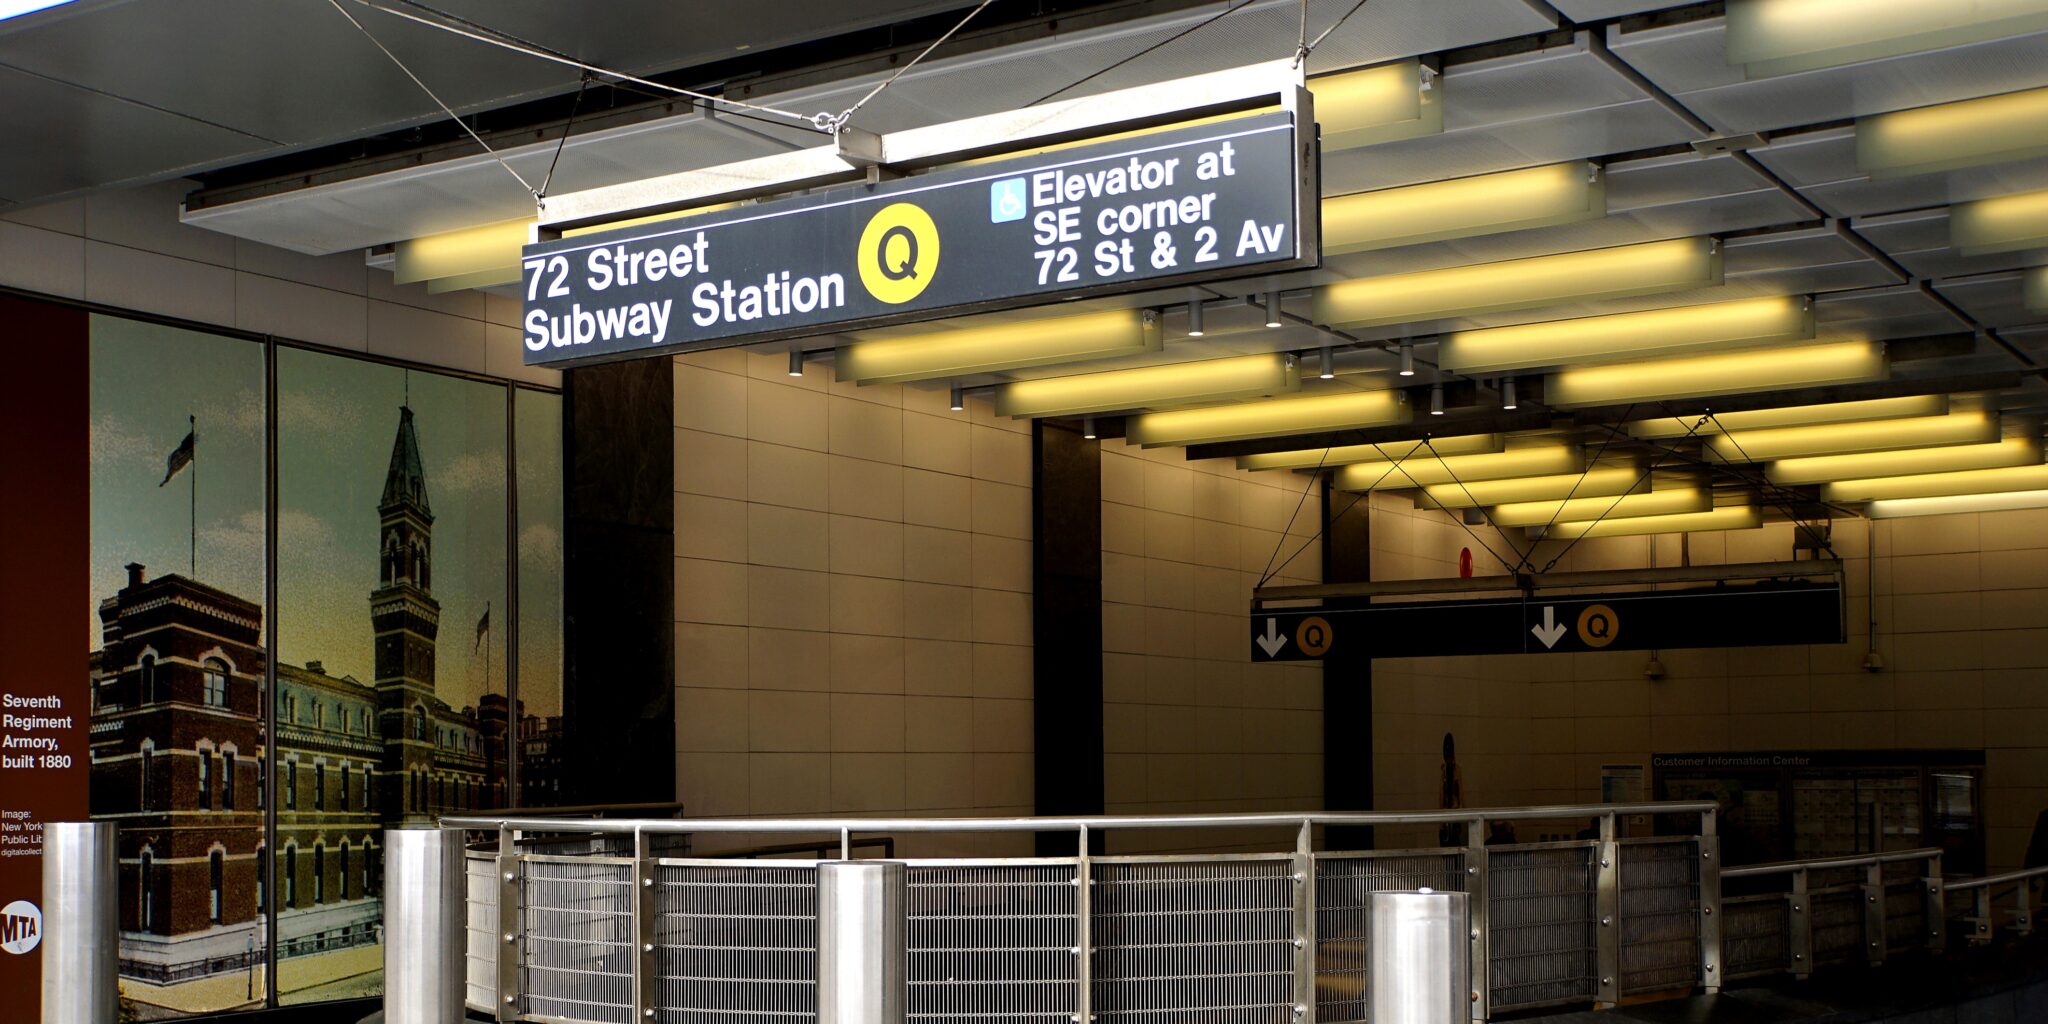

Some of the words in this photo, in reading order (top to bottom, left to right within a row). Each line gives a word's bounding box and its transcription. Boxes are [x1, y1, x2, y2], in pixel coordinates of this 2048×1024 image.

[1032, 154, 1179, 207] Elevator
[1197, 141, 1235, 180] at
[1034, 206, 1081, 246] SE
[1097, 192, 1216, 236] corner
[877, 225, 919, 281] Q
[1034, 247, 1079, 285] 72
[1094, 240, 1134, 277] St
[1150, 231, 1178, 270] &
[1194, 226, 1218, 263] 2
[1236, 219, 1285, 257] Av
[524, 256, 570, 301] 72
[587, 231, 709, 291] Street
[524, 299, 672, 351] Subway
[692, 271, 844, 327] Station
[1304, 625, 1324, 648] Q
[1587, 614, 1609, 638] Q
[3, 693, 61, 709] Seventh
[3, 713, 72, 731] Regiment
[2, 734, 58, 751] Armory,
[2, 755, 34, 769] built
[38, 755, 71, 769] 1880
[1653, 756, 1705, 767] Customer
[1708, 755, 1769, 766] Information
[1772, 755, 1810, 766] Center
[1, 809, 31, 820] Image:
[1, 822, 21, 831] New
[23, 821, 43, 831] York
[1, 835, 29, 844] Public
[0, 913, 37, 945] MTA
